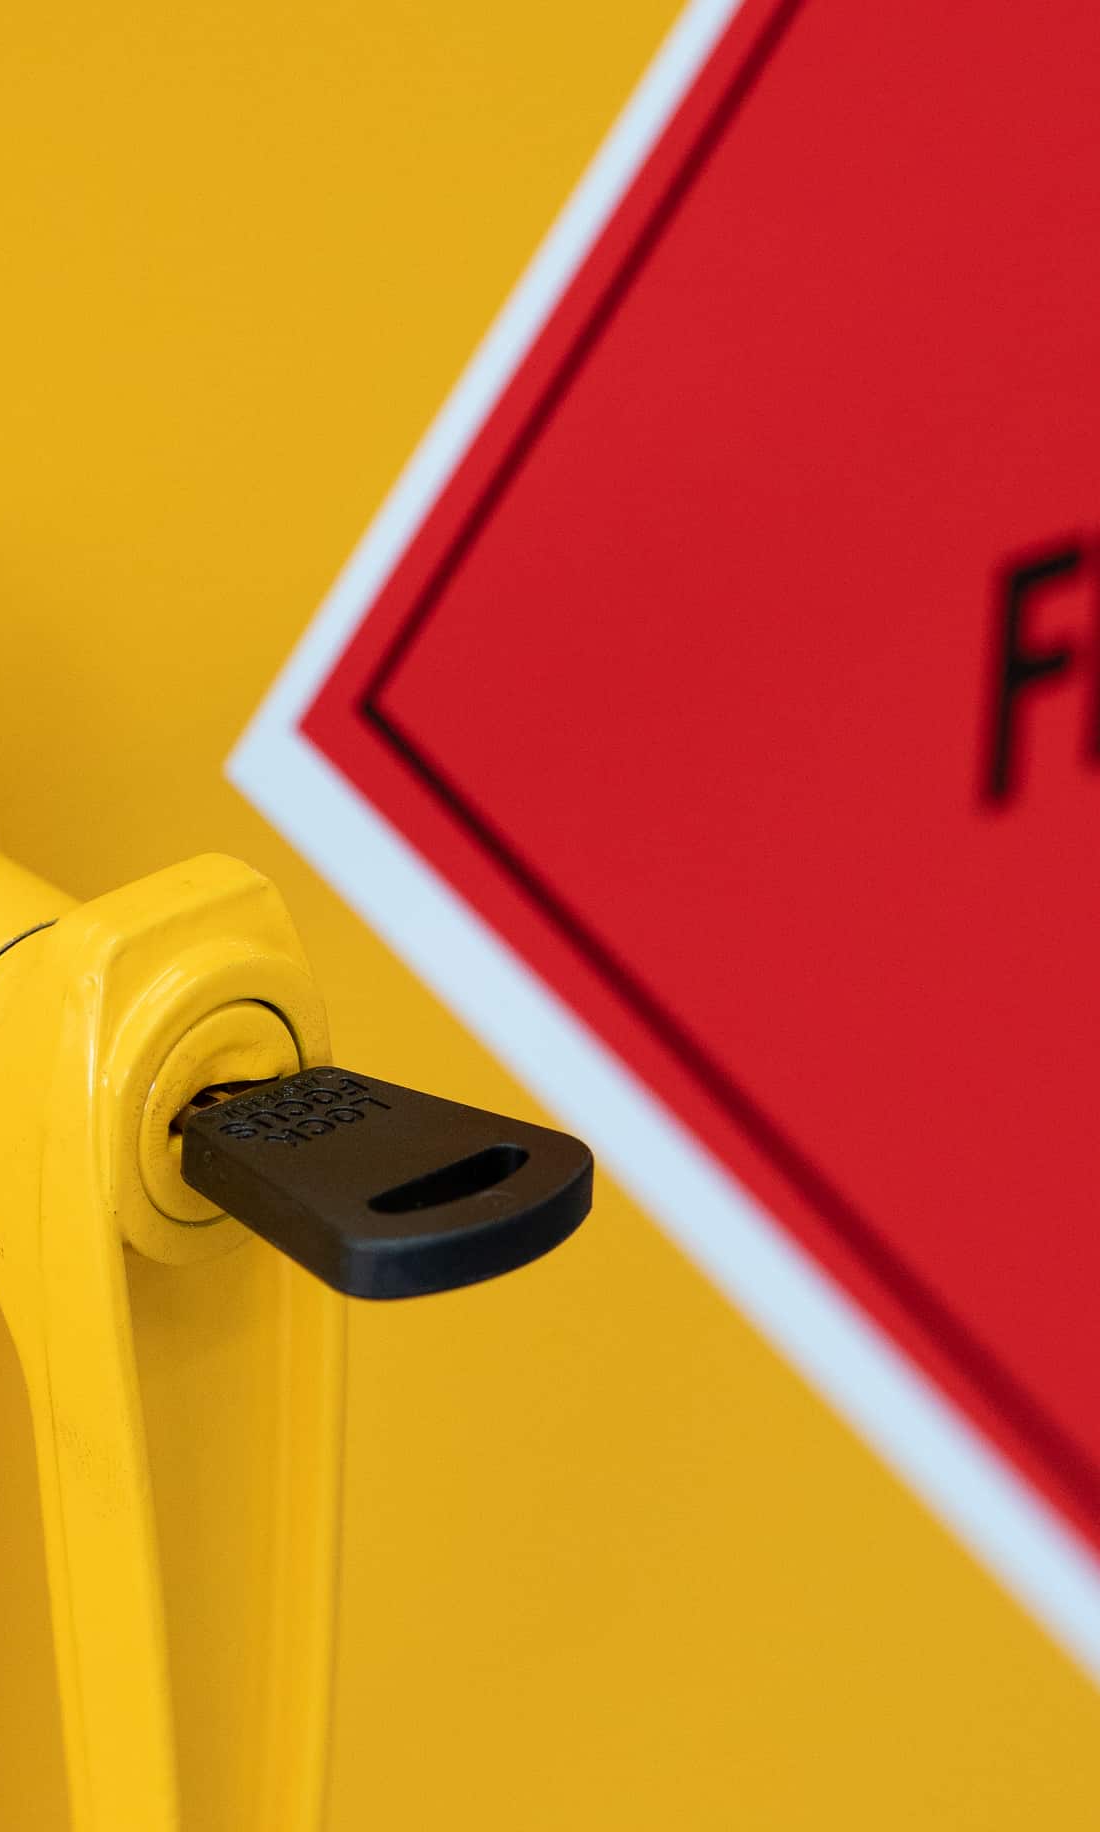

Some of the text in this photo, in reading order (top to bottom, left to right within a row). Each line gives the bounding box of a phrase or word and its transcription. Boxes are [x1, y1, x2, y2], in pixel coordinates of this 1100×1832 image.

[981, 533, 1100, 808] F
[218, 1077, 369, 1140] FOCUS
[264, 1096, 392, 1147] LOCK
